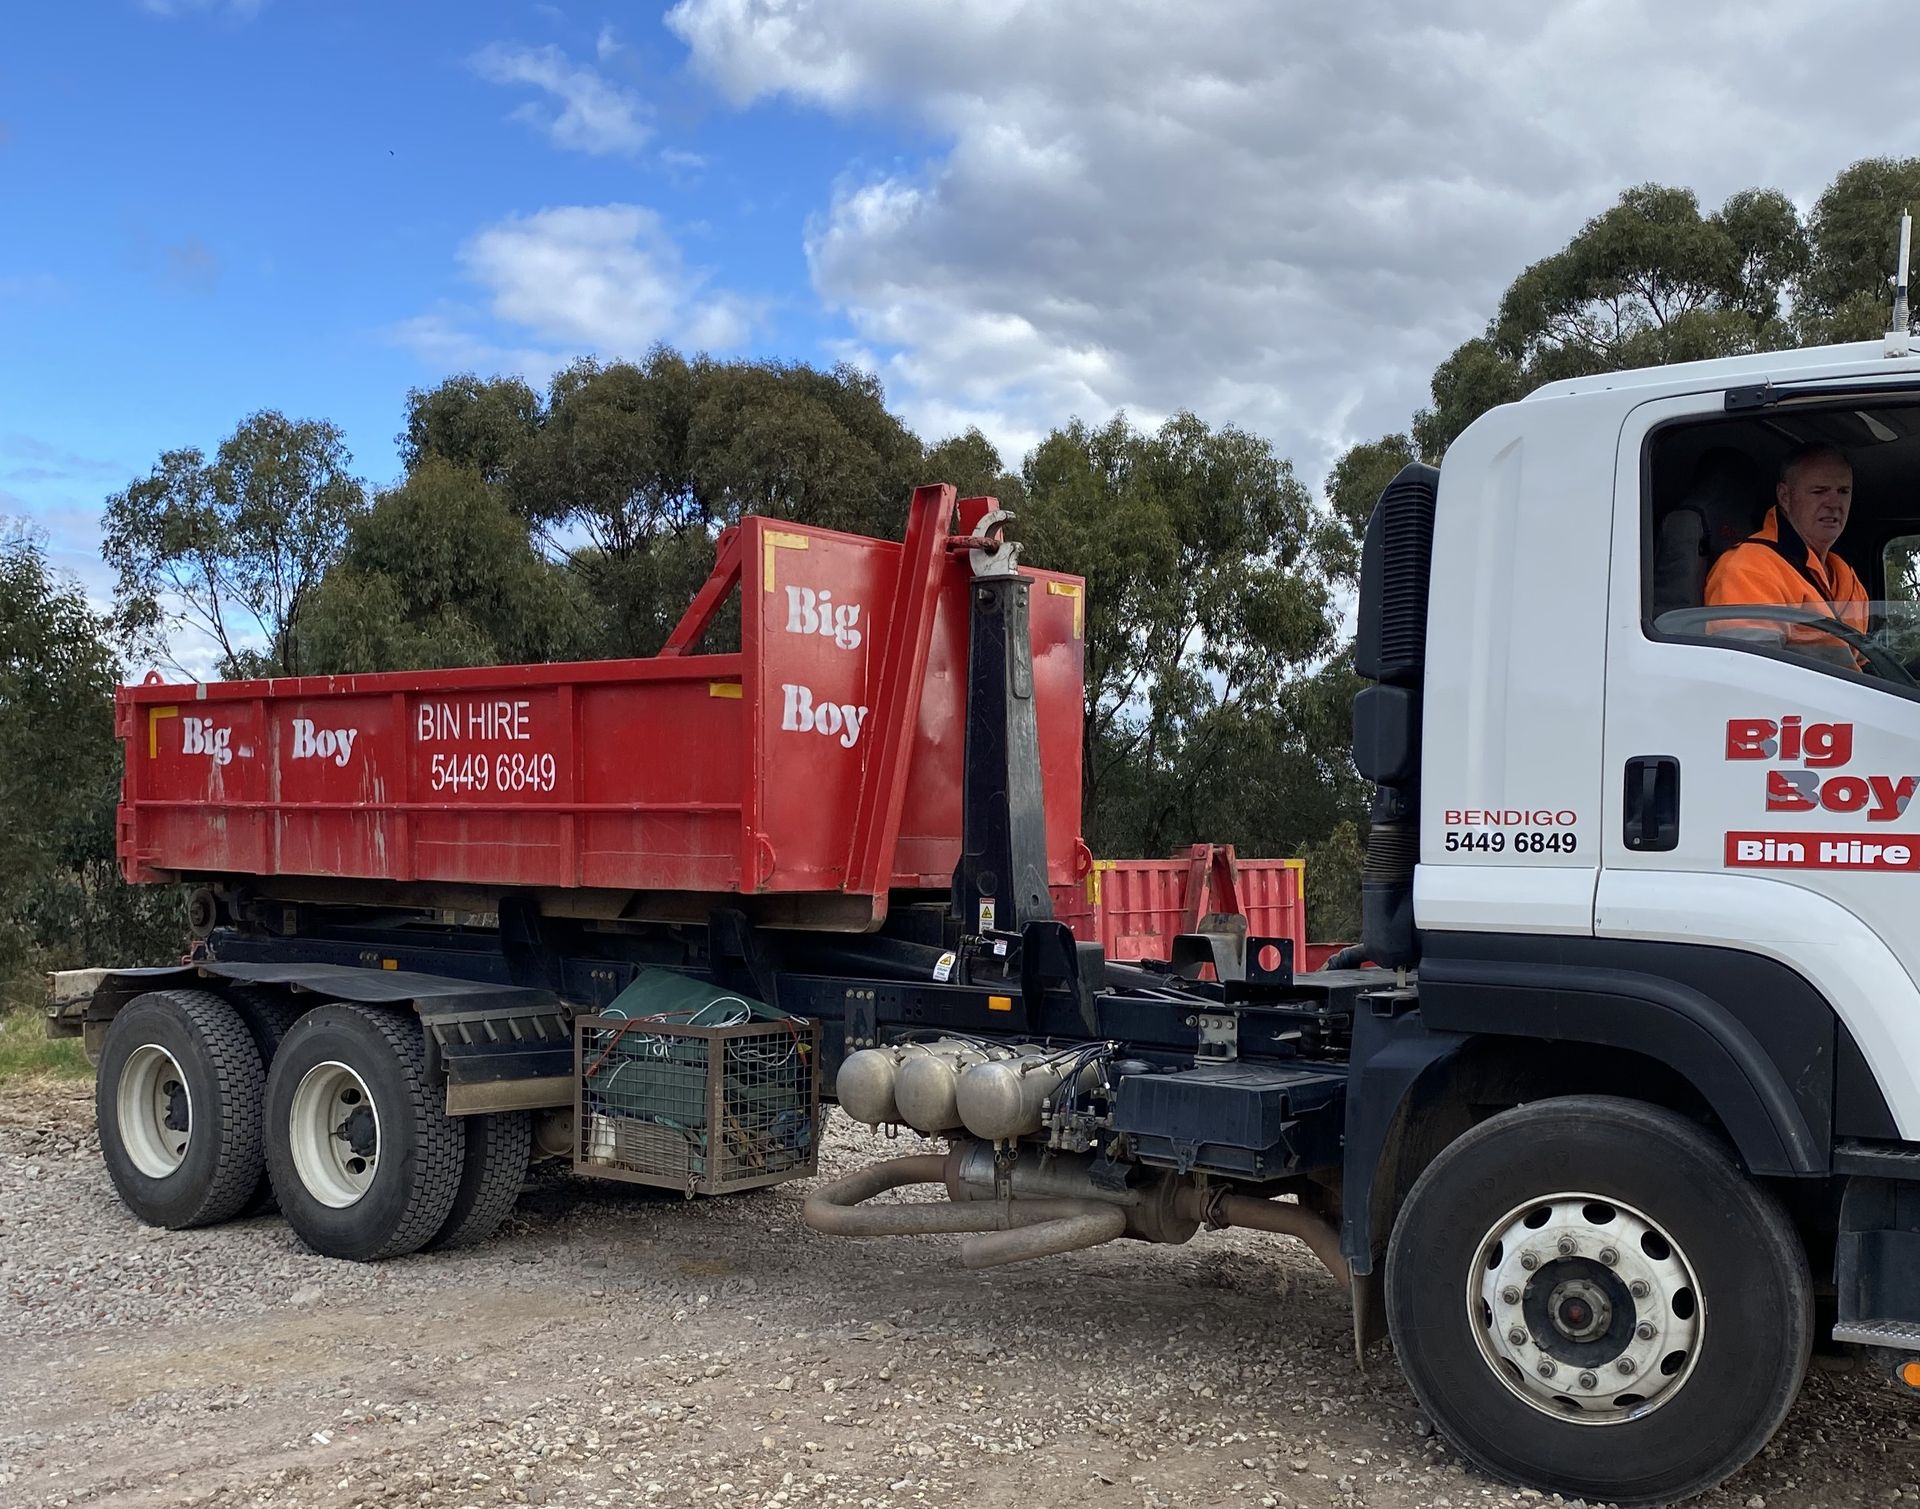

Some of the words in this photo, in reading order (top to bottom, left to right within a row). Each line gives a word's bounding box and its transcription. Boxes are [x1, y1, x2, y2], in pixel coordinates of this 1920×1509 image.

[785, 585, 861, 650] Big
[418, 702, 460, 742] BIN
[468, 701, 530, 741] HIRE
[781, 684, 868, 749] Boy
[182, 717, 232, 766] Big
[291, 719, 358, 768] Boy
[1725, 715, 1853, 768] Big
[431, 753, 488, 793] 5449
[496, 752, 556, 793] 6849
[1444, 810, 1577, 826] BENDIGO
[1765, 770, 1920, 822] Boy
[1444, 831, 1506, 853] 5449
[1514, 831, 1577, 853] 6849
[1737, 838, 1805, 862] Bin
[1819, 839, 1911, 865] Hire
